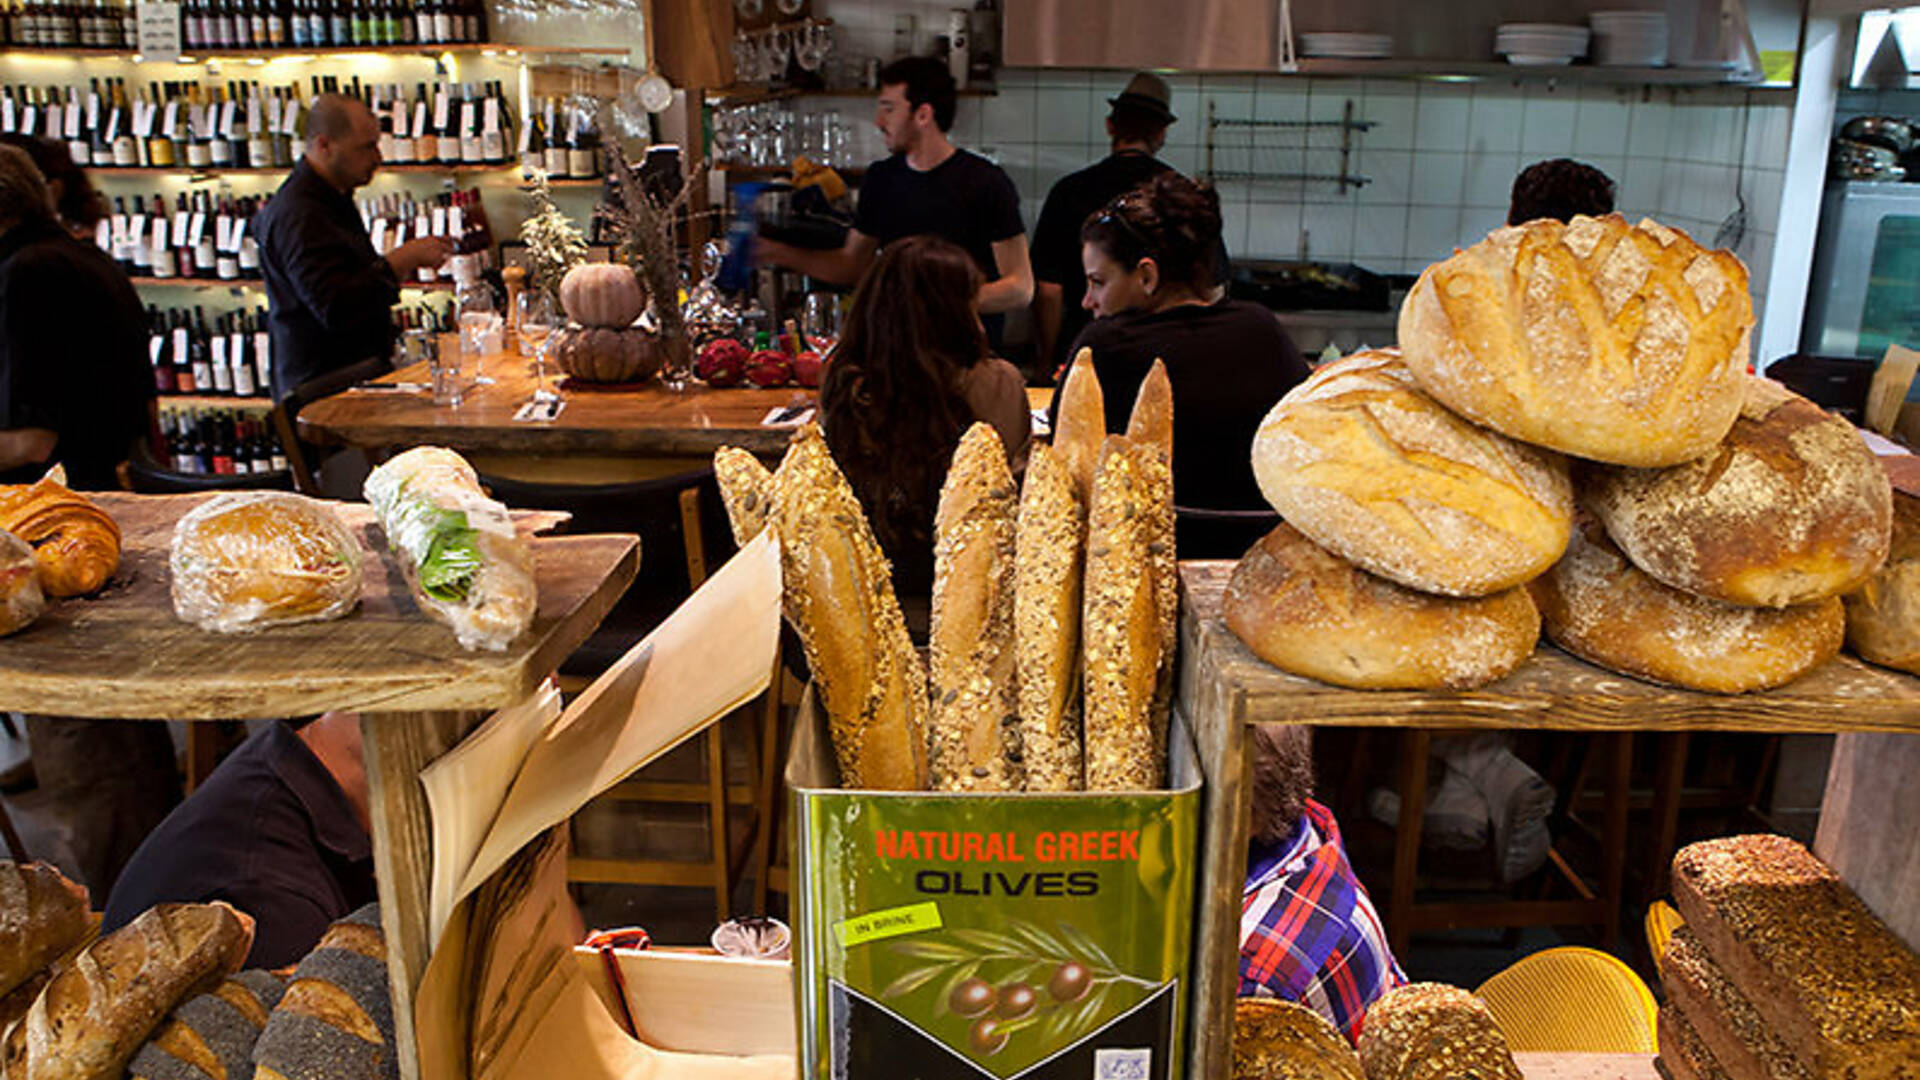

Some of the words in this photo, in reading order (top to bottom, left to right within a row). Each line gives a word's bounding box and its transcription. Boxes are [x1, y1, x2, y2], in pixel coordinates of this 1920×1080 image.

[875, 829, 1025, 863] NATURAL
[1035, 830, 1139, 863] GREEK
[915, 869, 1099, 897] OLIVES
[855, 922, 871, 935] IN
[873, 913, 915, 930] BRINE
